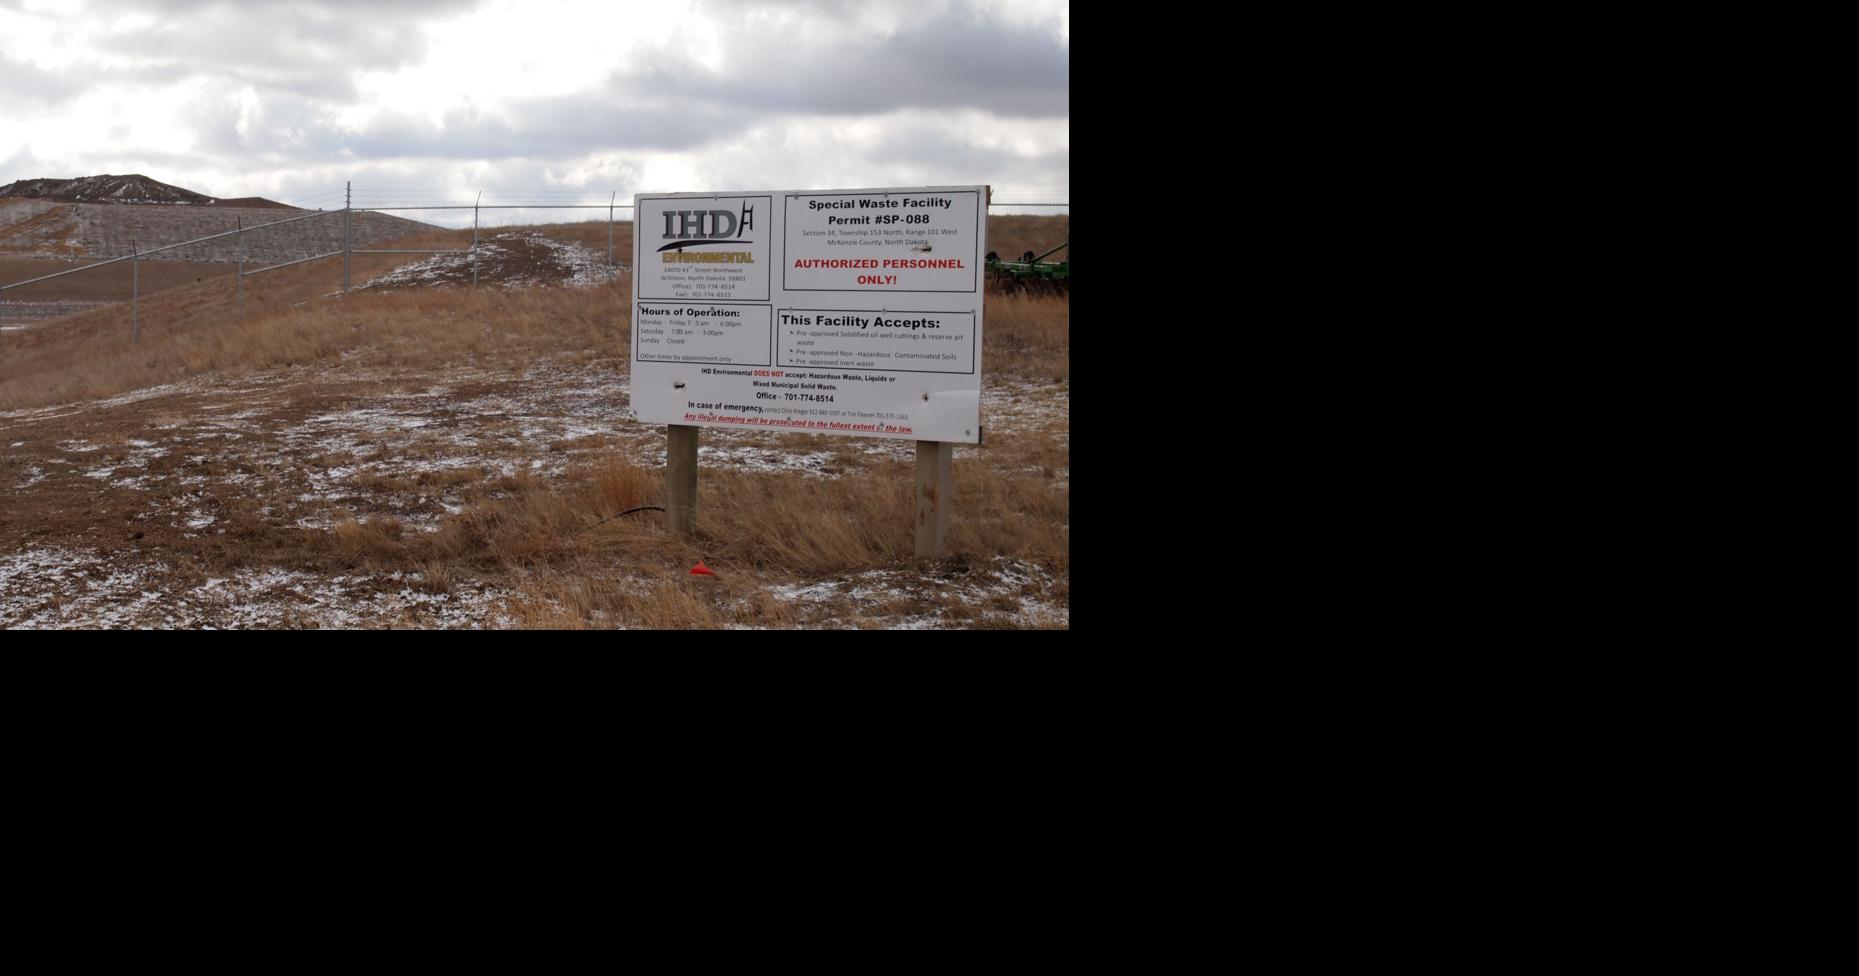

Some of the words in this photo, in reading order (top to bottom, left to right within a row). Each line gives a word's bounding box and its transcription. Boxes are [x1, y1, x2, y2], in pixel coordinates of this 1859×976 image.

[809, 200, 854, 210] Special
[859, 200, 898, 208] Waste
[903, 198, 952, 208] Facility
[662, 210, 738, 239] IHD
[828, 216, 870, 224] Permit
[875, 215, 930, 224] #SP-088
[906, 229, 925, 237] Range
[662, 252, 754, 264] ENVIRONMENTAL
[794, 259, 878, 268] AUTHORIZED
[883, 259, 964, 268] PERSONNEL
[858, 276, 896, 284] ONLY!
[642, 308, 670, 316] Hours
[687, 308, 740, 318] Operation:
[782, 314, 811, 326] This
[816, 316, 869, 328] Facility
[874, 317, 940, 330] Accepts:
[894, 332, 920, 340] cuttings
[771, 381, 799, 390] Municipal
[756, 392, 776, 400] Office
[784, 393, 834, 402] 701-774-8514
[724, 404, 764, 414] emergency,
[698, 414, 716, 422] illegal
[718, 416, 746, 424] dumping
